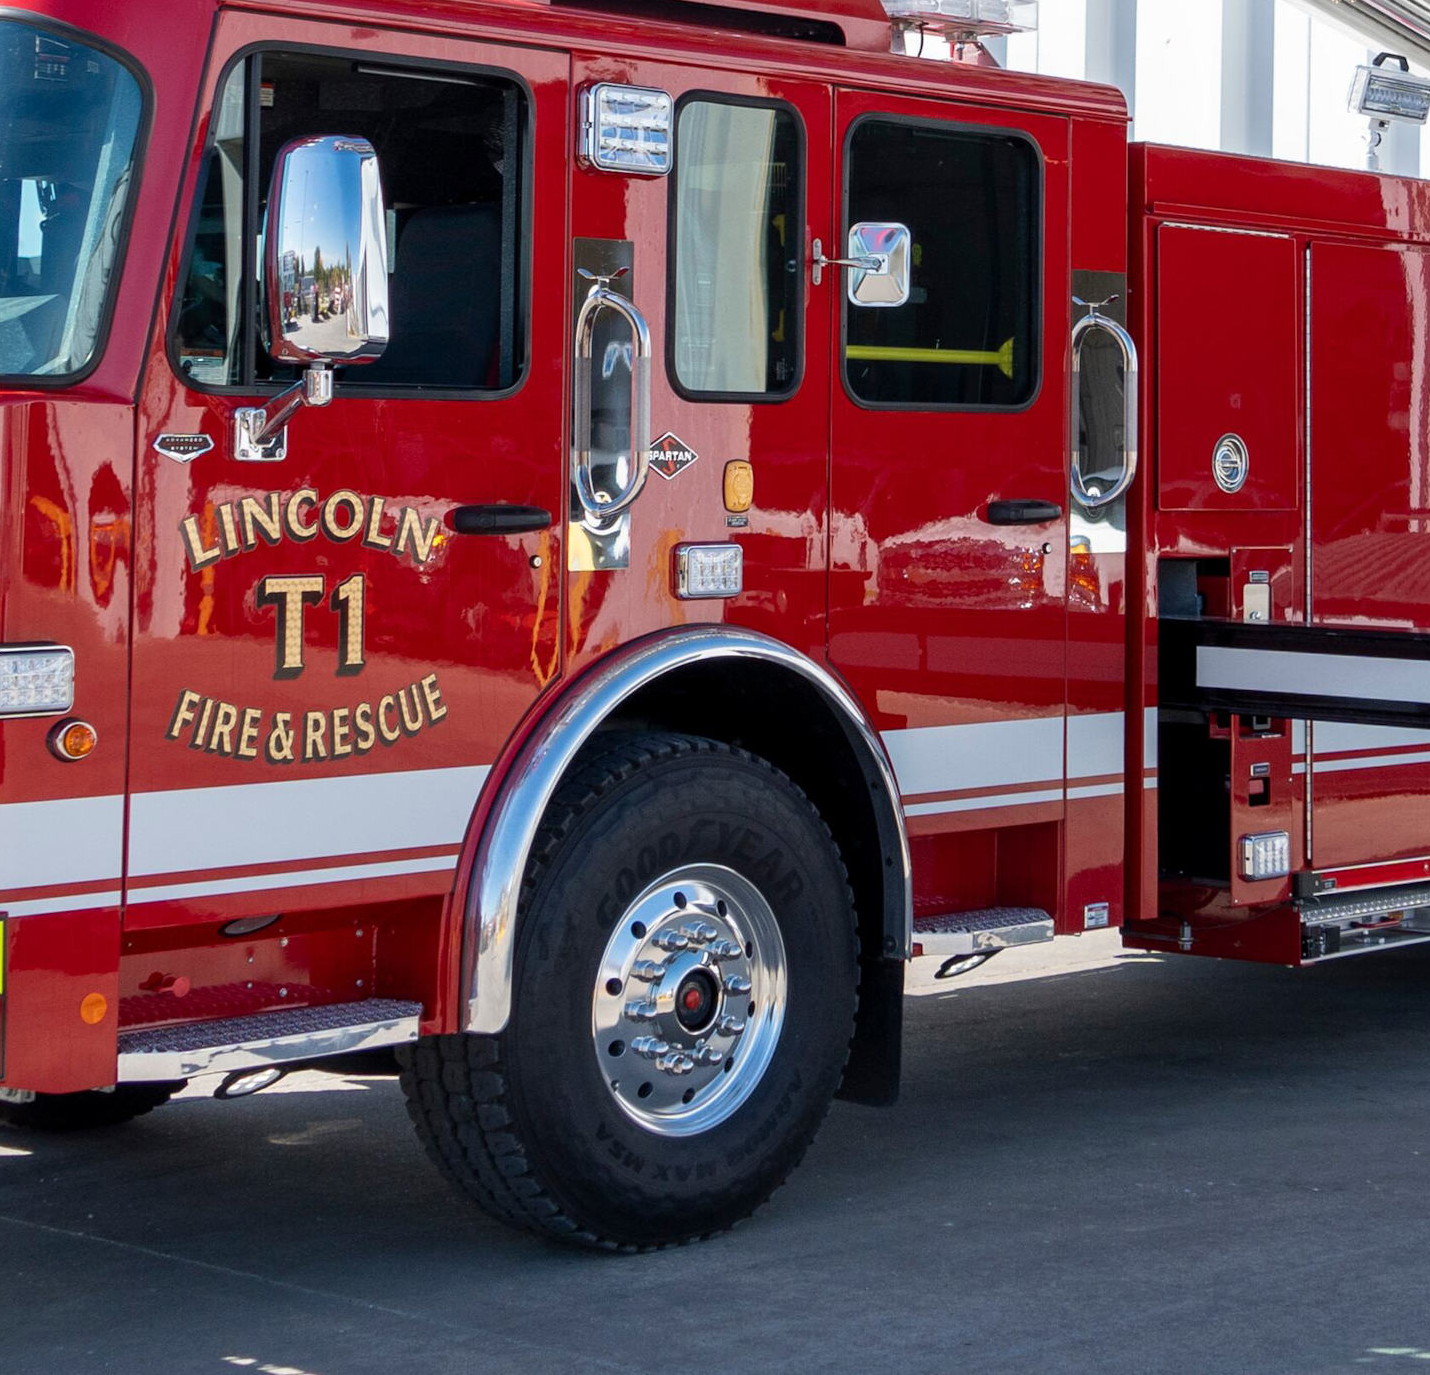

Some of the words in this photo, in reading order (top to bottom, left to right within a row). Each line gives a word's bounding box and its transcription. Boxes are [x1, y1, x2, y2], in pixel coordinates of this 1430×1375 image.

[649, 450, 692, 461] SPARTAN
[179, 488, 441, 573] LINCOLN
[256, 573, 366, 681] T1
[165, 688, 263, 759] FIRE
[300, 673, 449, 764] RESCUE
